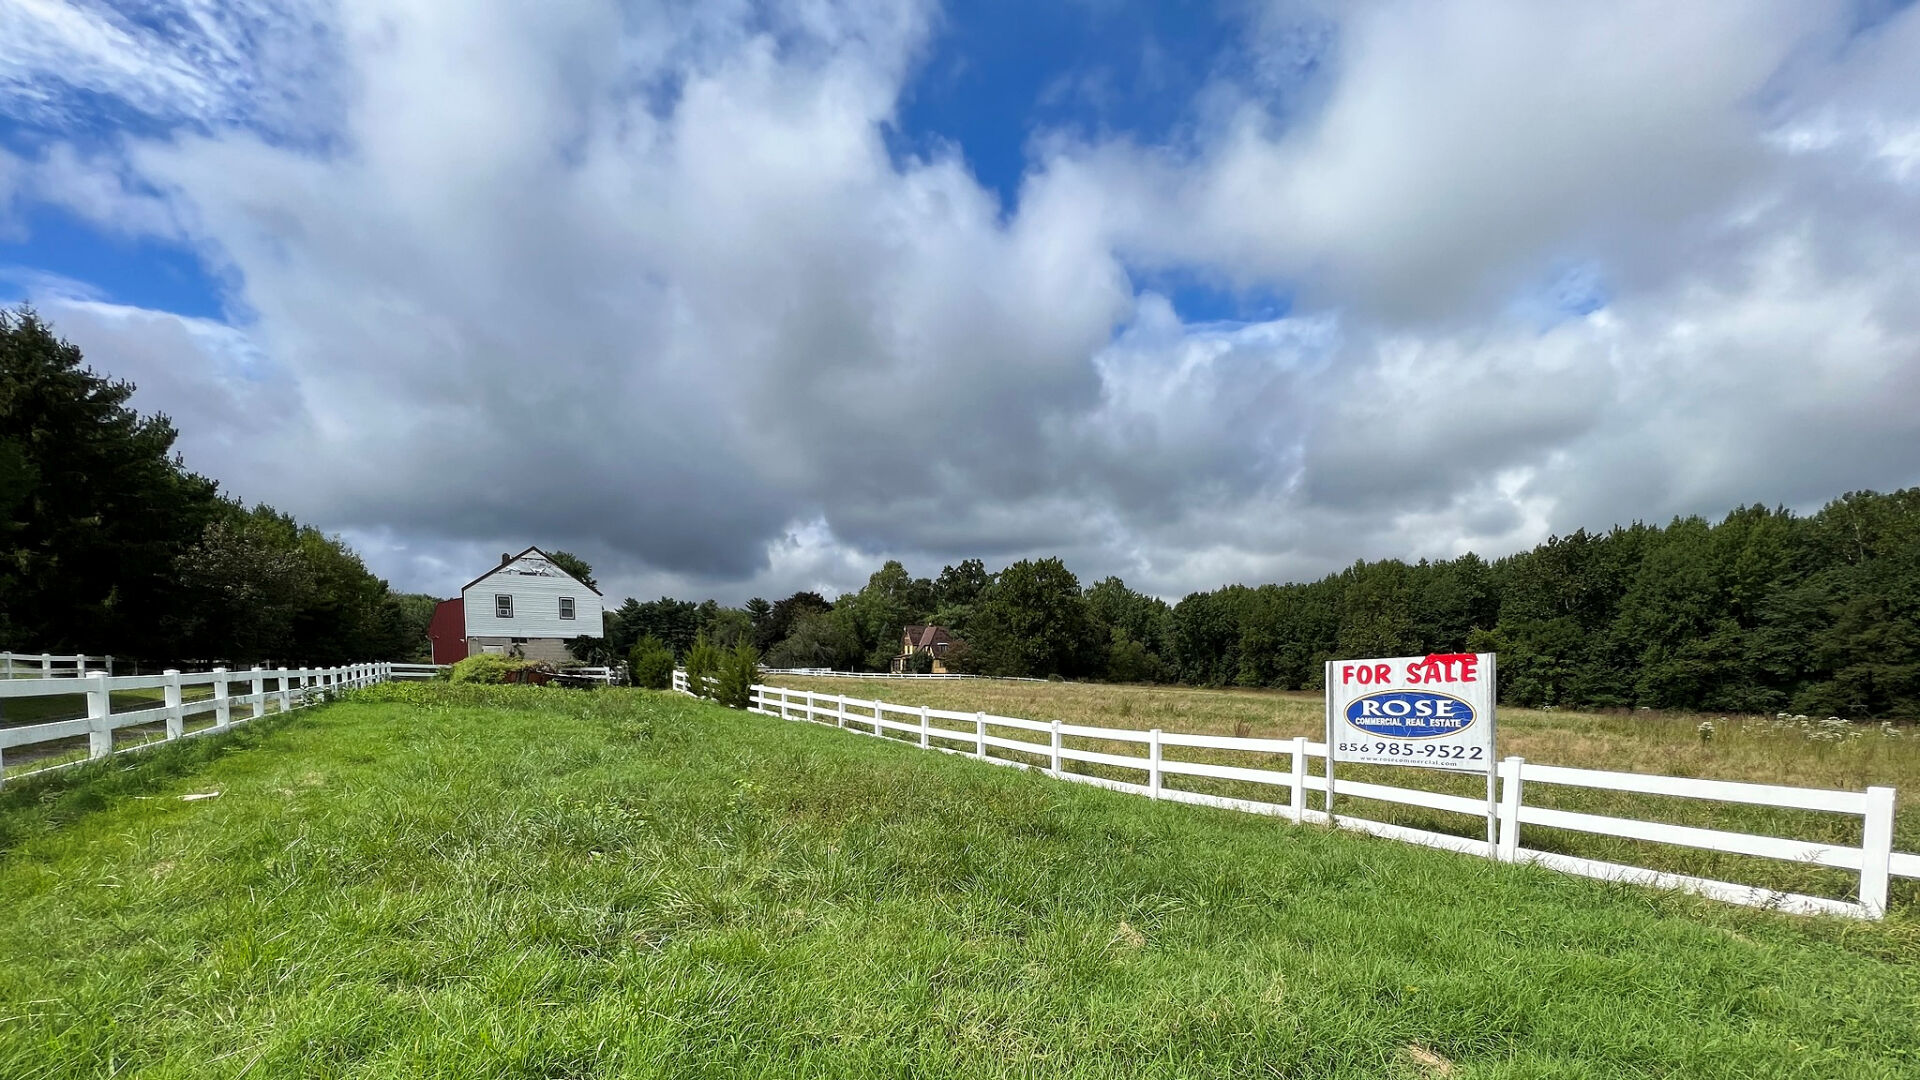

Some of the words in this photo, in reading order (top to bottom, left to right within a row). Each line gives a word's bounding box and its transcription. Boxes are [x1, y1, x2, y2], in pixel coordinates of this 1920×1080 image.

[1342, 664, 1391, 685] FOR
[1405, 661, 1478, 685] SALE
[1361, 699, 1455, 717] ROSE
[1355, 717, 1402, 727] COMMERCIAL
[1405, 718, 1426, 727] REAL
[1430, 718, 1462, 728] ESTATE
[1339, 742, 1369, 752] 856
[1375, 742, 1483, 760] 985-9522
